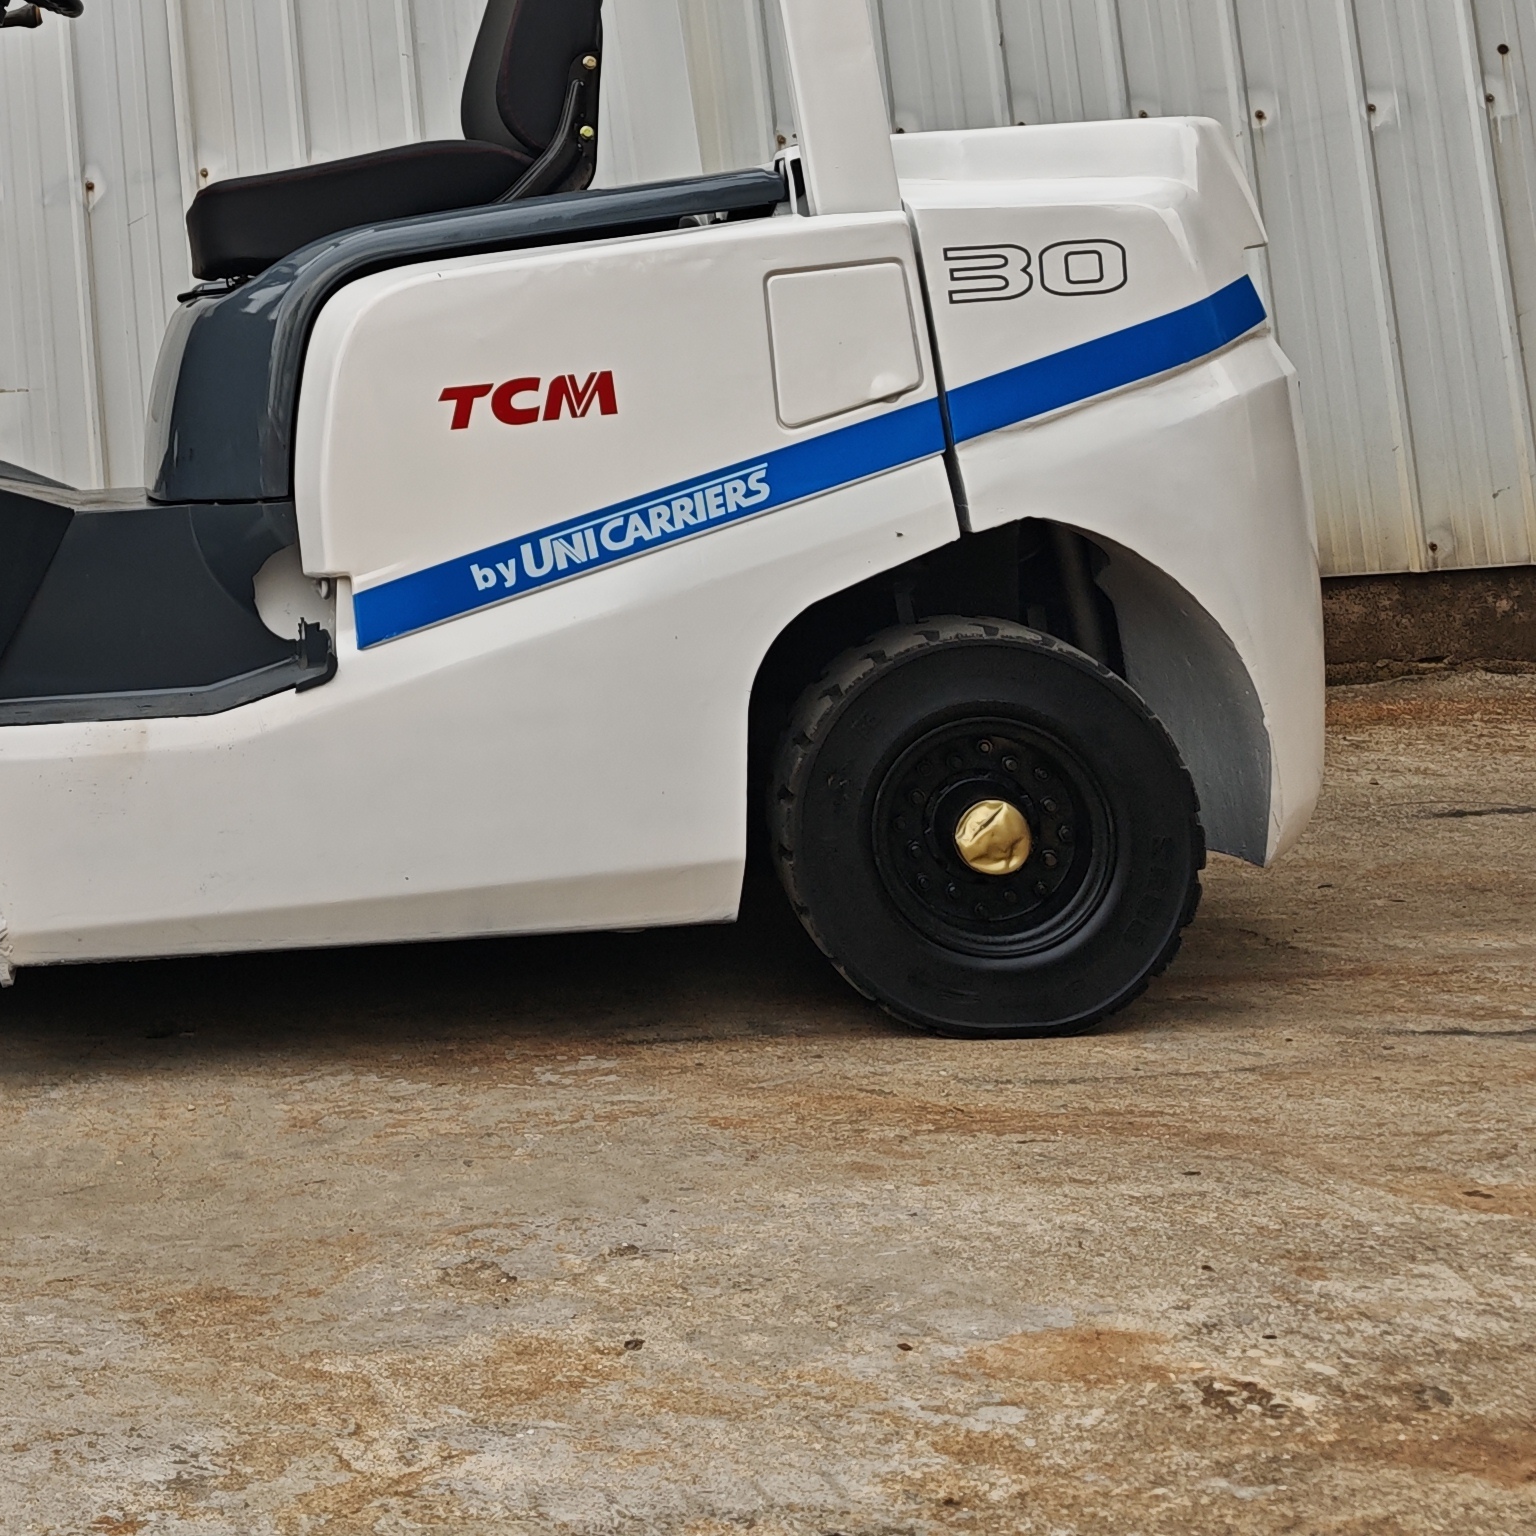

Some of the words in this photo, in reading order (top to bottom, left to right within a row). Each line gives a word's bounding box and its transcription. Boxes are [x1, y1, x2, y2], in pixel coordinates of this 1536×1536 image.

[942, 238, 1128, 305] 30
[438, 369, 619, 430] TCM
[470, 557, 517, 592] by
[520, 462, 771, 578] UNICARRIERS
